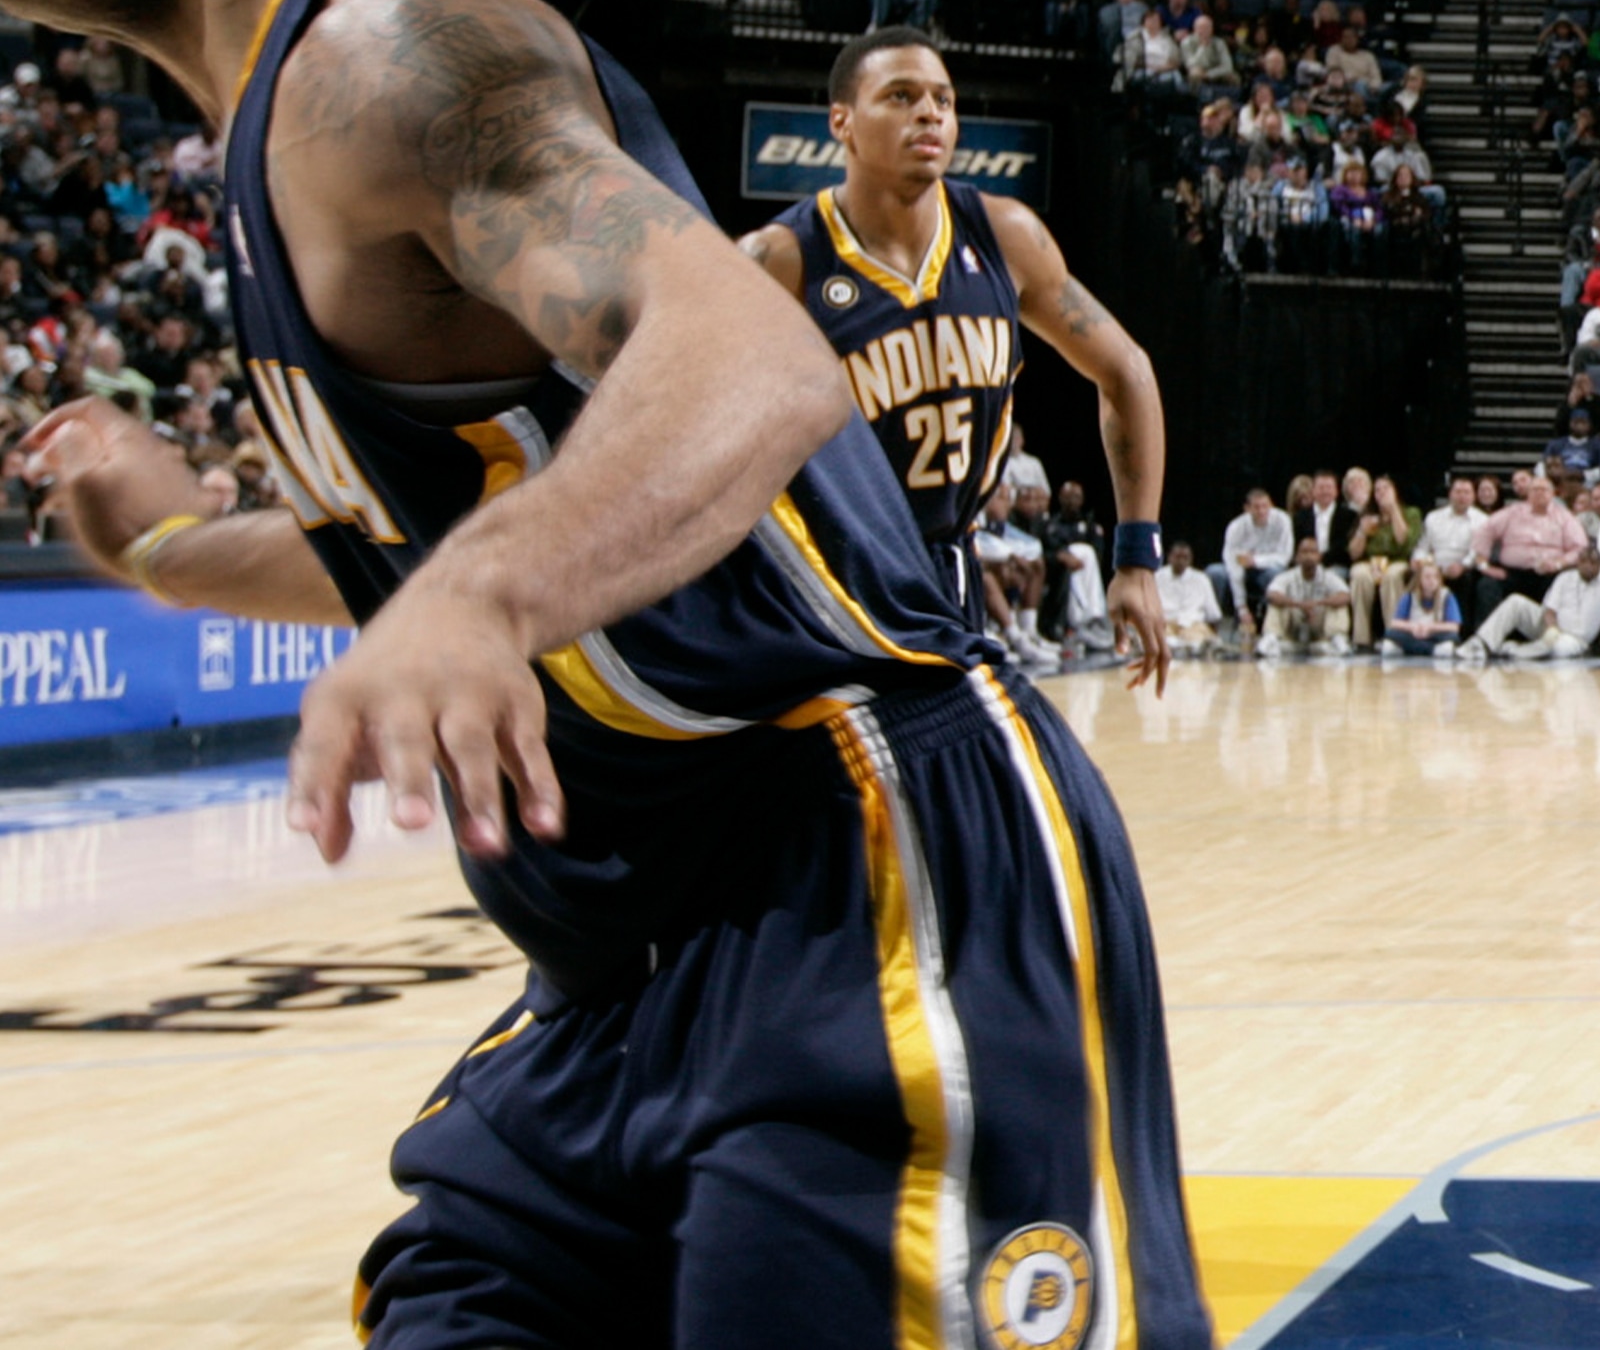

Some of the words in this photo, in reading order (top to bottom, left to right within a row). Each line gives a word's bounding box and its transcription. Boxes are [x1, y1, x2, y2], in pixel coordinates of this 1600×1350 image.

[946, 148, 1037, 178] GHT
[841, 314, 1010, 423] NDIANA
[904, 396, 974, 490] 25
